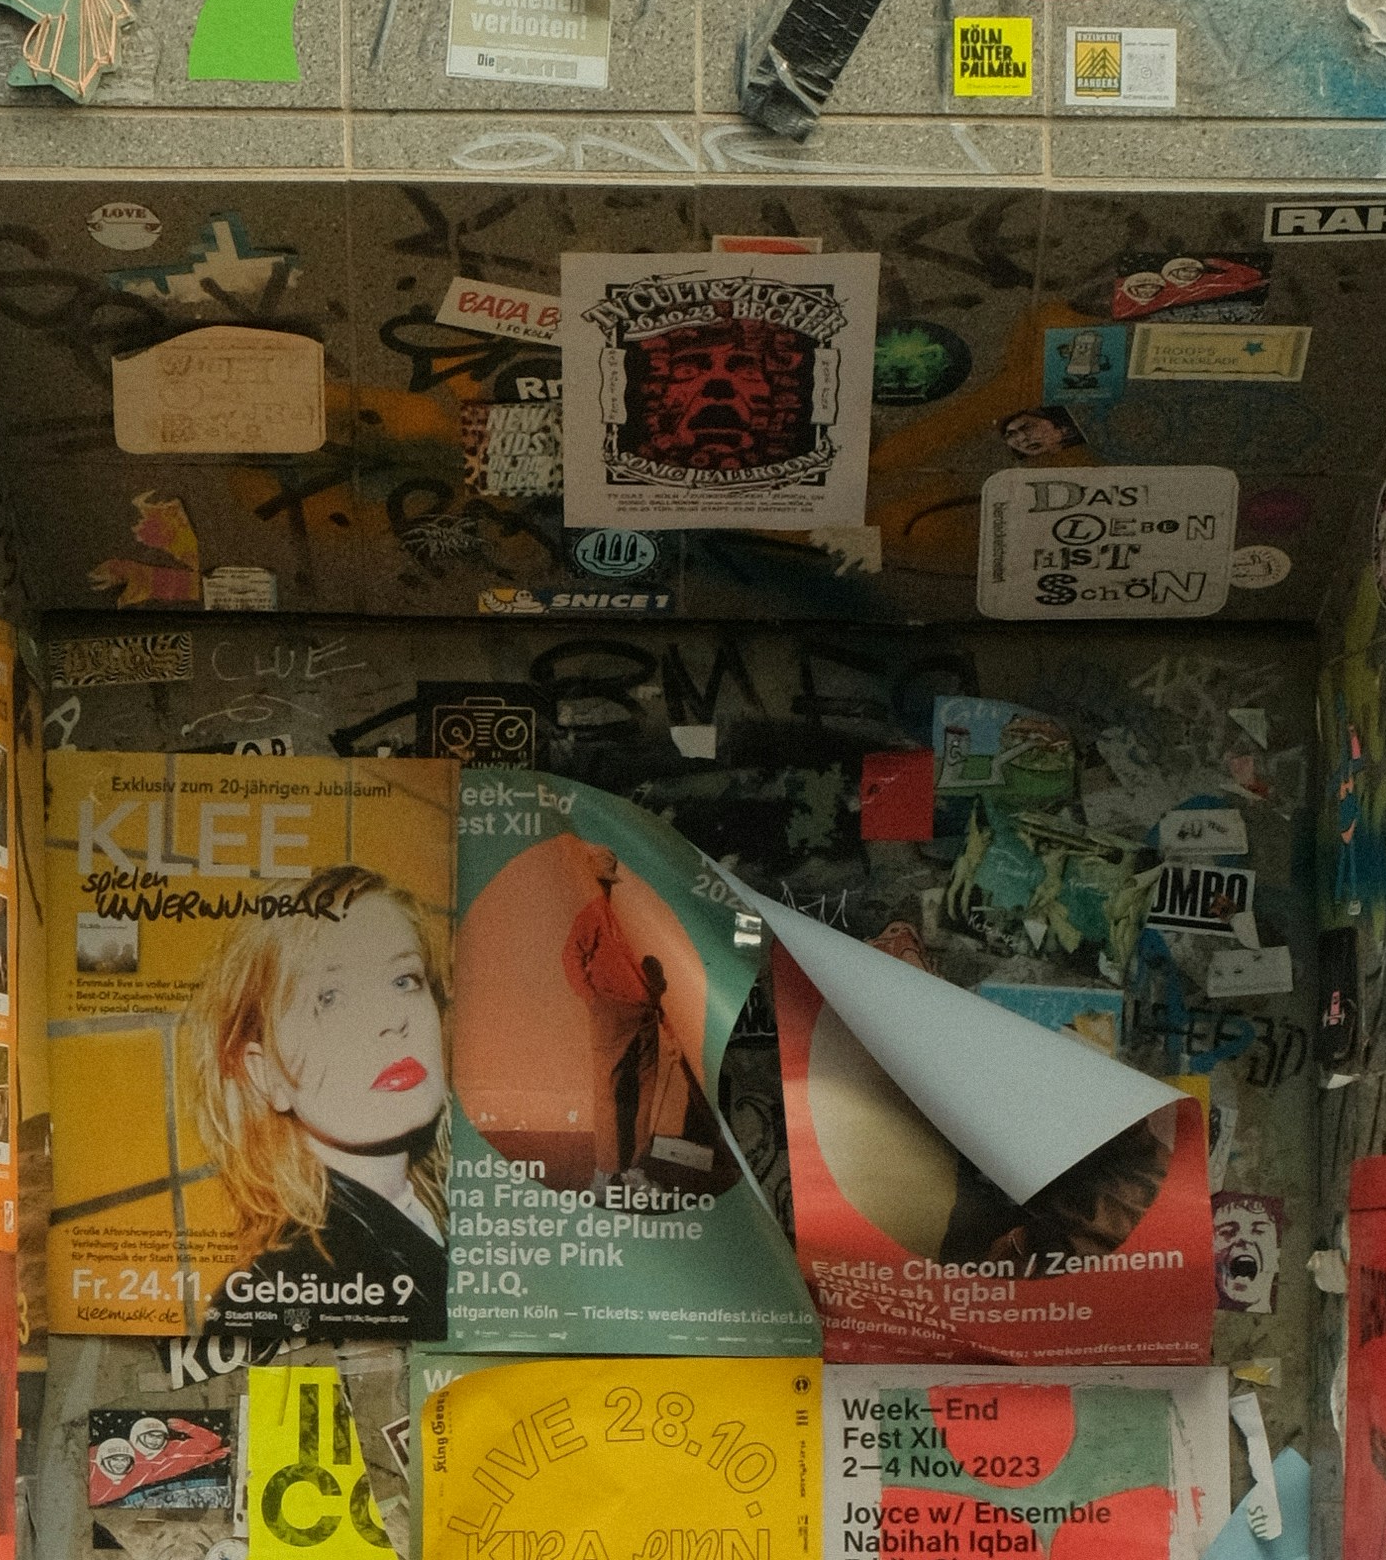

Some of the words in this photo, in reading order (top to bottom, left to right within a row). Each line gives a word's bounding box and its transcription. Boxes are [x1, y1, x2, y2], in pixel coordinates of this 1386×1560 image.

[471, 9, 587, 40] verboten!
[961, 27, 1003, 44] KÖLN
[477, 53, 495, 67] Die
[961, 44, 1013, 62] UNTER
[961, 61, 1026, 78] PALMEN
[102, 206, 147, 220] LOVE
[552, 595, 648, 608] SNICE
[112, 778, 174, 795] Exklusiv
[180, 782, 214, 795] zum
[219, 779, 310, 799] 20-jährigen
[314, 781, 392, 799] Jubiläum!
[77, 801, 313, 878] KLEE
[82, 870, 168, 895] spielen
[97, 893, 354, 922] UNVERWUNDBAR!
[72, 1269, 112, 1301] Fr.
[118, 1269, 212, 1301] 24.11.
[225, 1271, 384, 1305] Gebäude
[391, 1274, 414, 1306] 9
[843, 1427, 902, 1449] Fest
[911, 1427, 948, 1449] XII
[450, 1398, 586, 1540] LIVE
[605, 1387, 778, 1517] 28.10.
[911, 1456, 965, 1478] Nov
[974, 1456, 1041, 1478] 2023
[843, 1502, 920, 1529] Joyce
[930, 1502, 965, 1524] w/
[975, 1502, 1111, 1524] Ensemble
